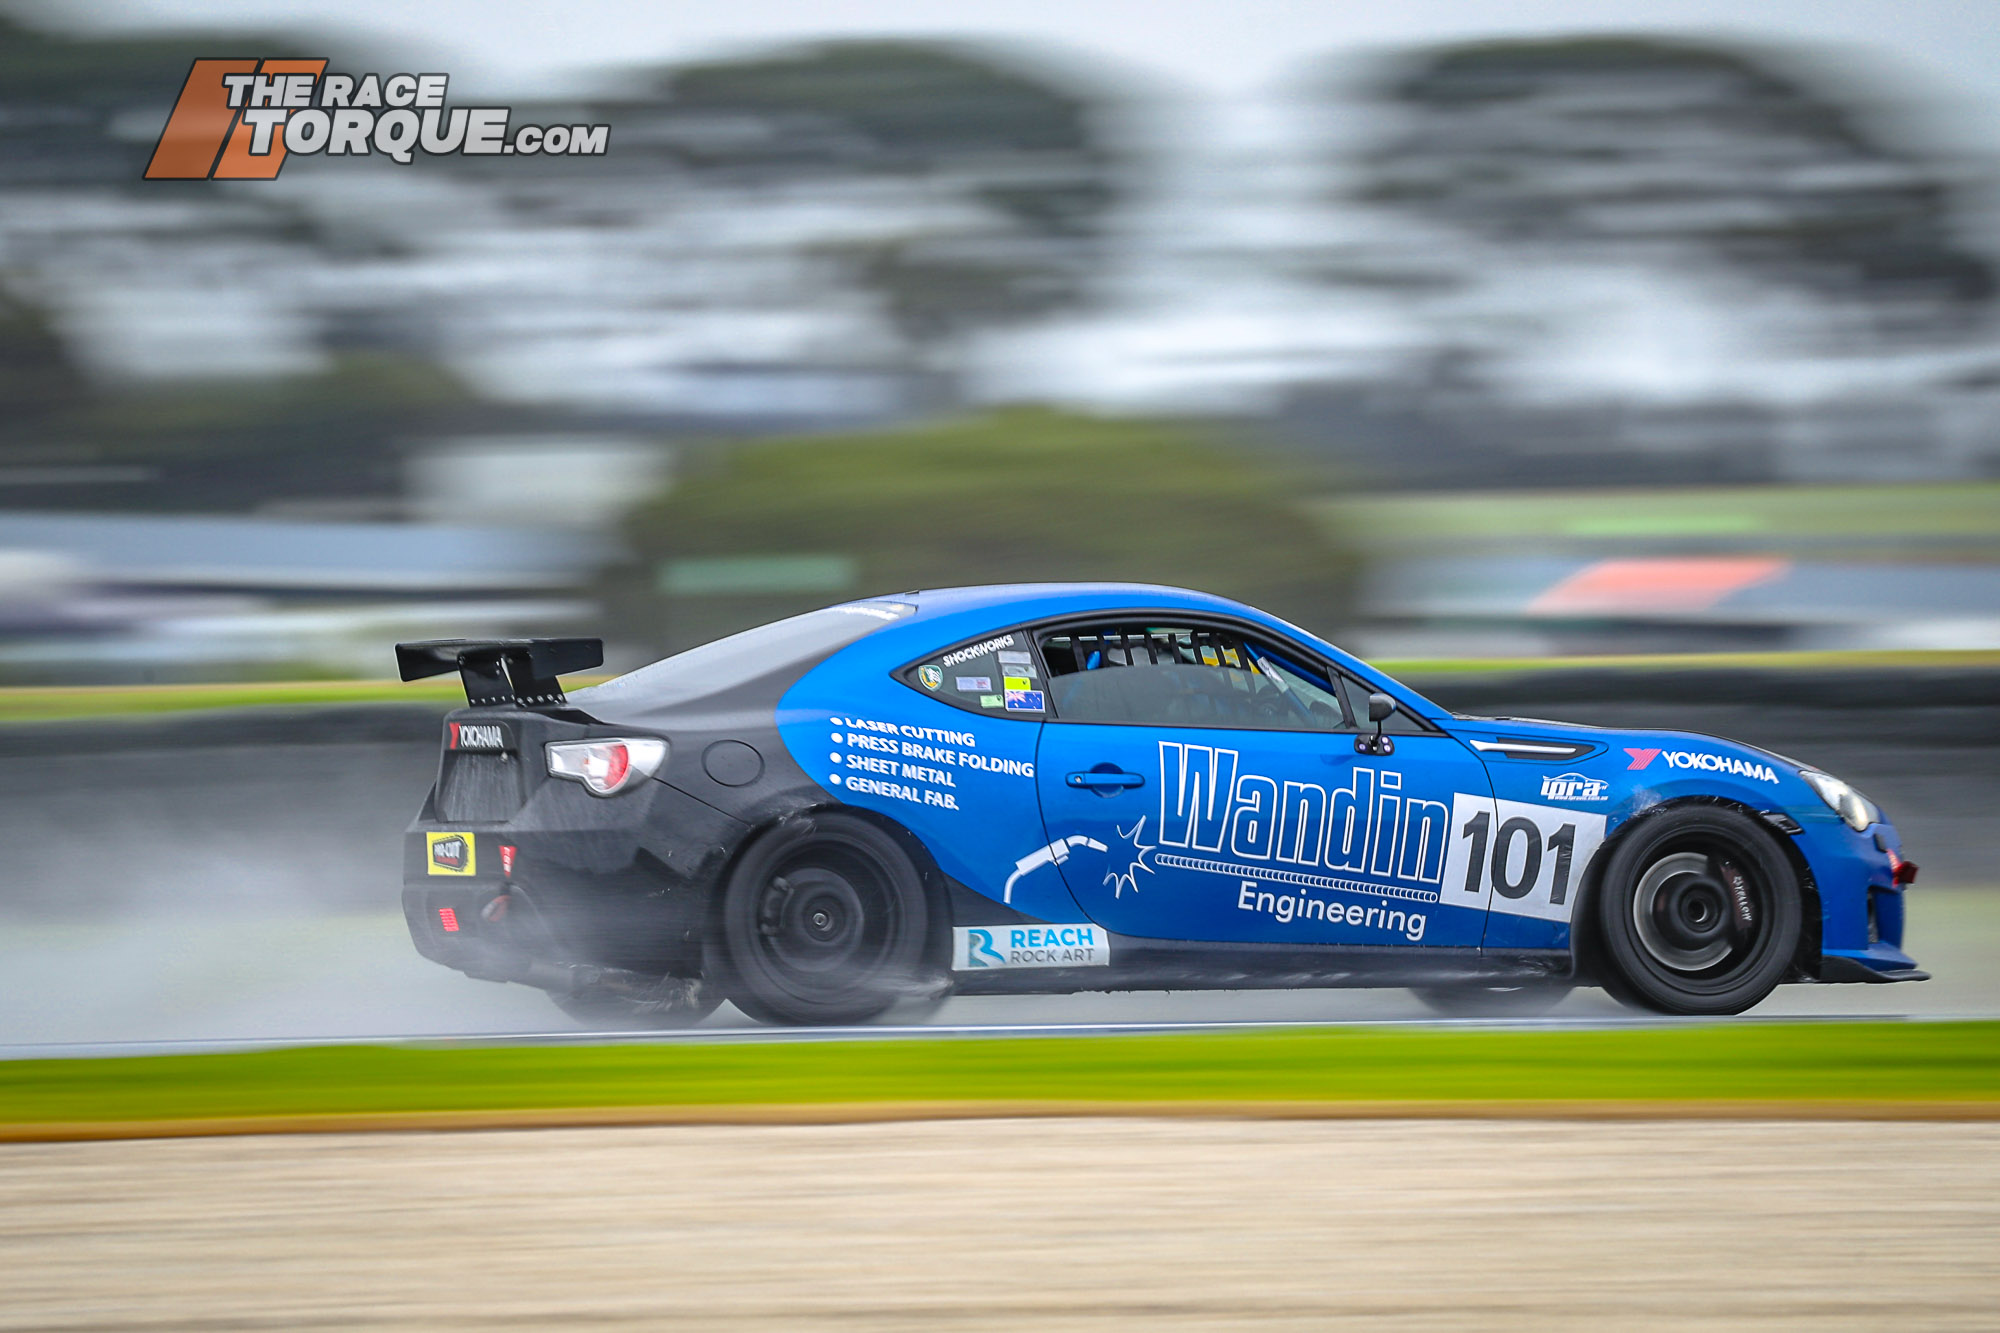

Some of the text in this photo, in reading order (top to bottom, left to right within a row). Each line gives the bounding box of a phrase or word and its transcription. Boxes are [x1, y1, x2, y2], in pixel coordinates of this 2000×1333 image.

[943, 634, 1015, 667] SHOCKWORKS
[459, 725, 504, 748] YOKOHAMA
[844, 718, 975, 747] LASER CUTTING
[846, 754, 956, 788] SHEET METAL
[847, 733, 1034, 778] PRESS BRAKE FOLDING
[1661, 751, 1779, 784] YOKOHAMA
[845, 776, 959, 811] GENERAL FAB.
[1158, 741, 1449, 884] Wandin
[1462, 810, 1576, 905] 101
[1237, 880, 1427, 942] Engineering
[1011, 928, 1094, 948] REACH
[1011, 948, 1095, 964] ROCK ART
